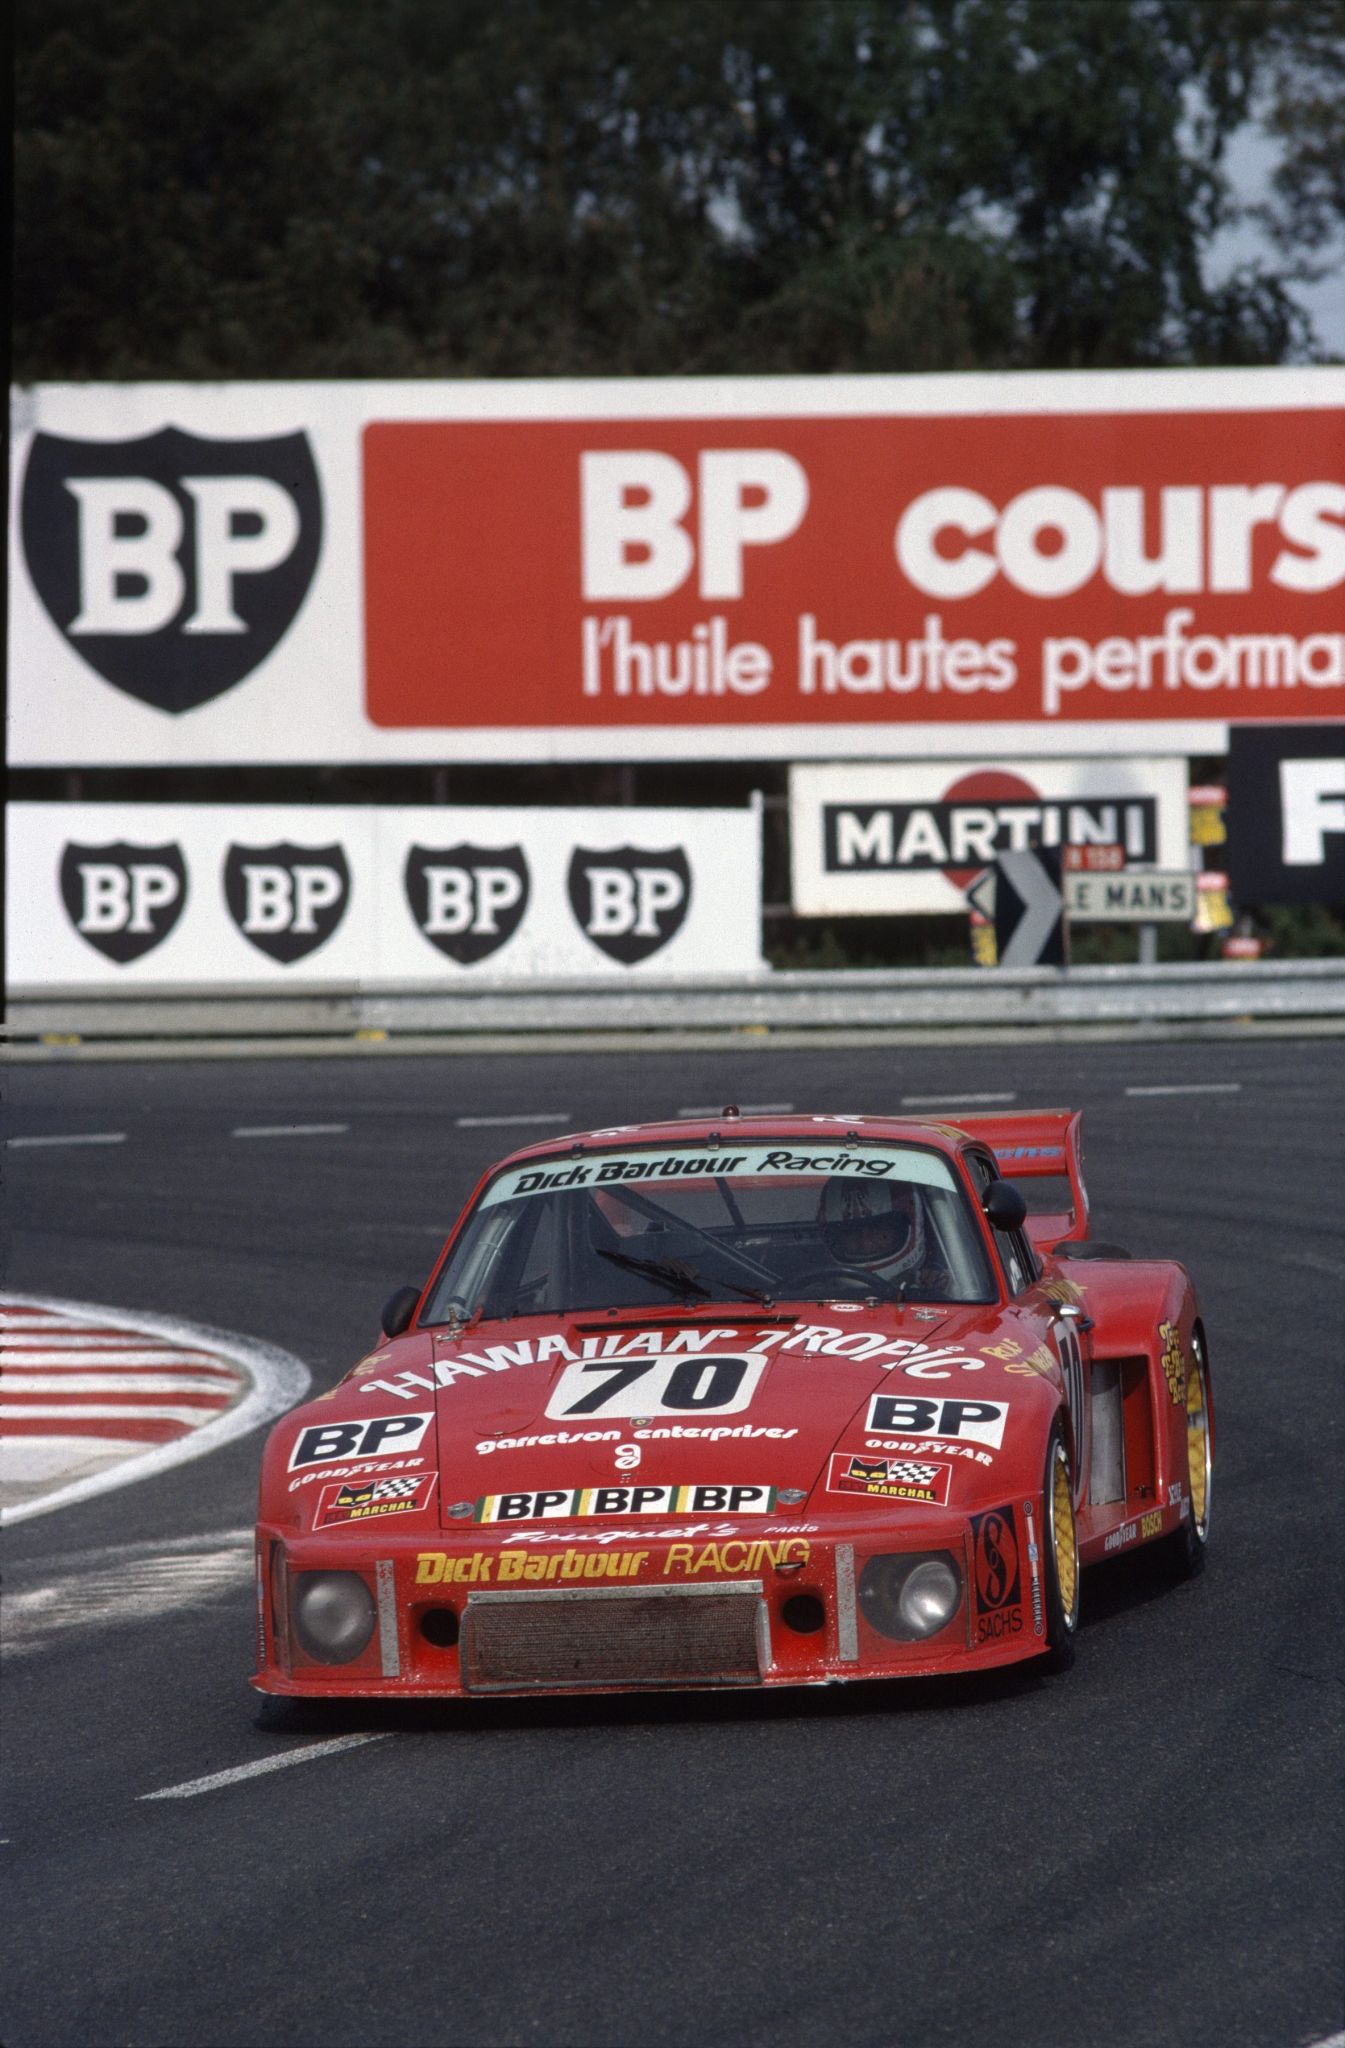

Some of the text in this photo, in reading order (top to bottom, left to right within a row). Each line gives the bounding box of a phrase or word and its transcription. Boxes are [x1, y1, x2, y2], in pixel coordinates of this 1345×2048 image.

[579, 448, 1345, 602] BP cours
[62, 475, 301, 636] BP
[582, 607, 1345, 715] l'huile hautes performa
[835, 806, 1146, 864] MARTINI
[77, 863, 181, 933] BP
[241, 863, 344, 933] BP
[422, 865, 523, 935] BP
[584, 866, 685, 936] BP
[1065, 883, 1187, 911] E MANS
[512, 1151, 897, 1196] Dick Barbour Racing
[358, 1331, 739, 1400] HAWAIIAN
[746, 1323, 986, 1380] TROPIC
[560, 1357, 749, 1416] 70
[475, 1424, 799, 1455] garretson enterprises
[870, 1396, 1001, 1436] BP
[293, 1416, 424, 1468] BP
[288, 1457, 425, 1492] GOODYEAR
[866, 1483, 934, 1501] MARCHAL
[350, 1500, 414, 1518] MARCHAL
[497, 1486, 763, 1521] BP BP BP
[1141, 1511, 1163, 1539] BOSCH
[414, 1537, 811, 1585] Dick Barbour RACING
[978, 1608, 1023, 1643] SACHS
